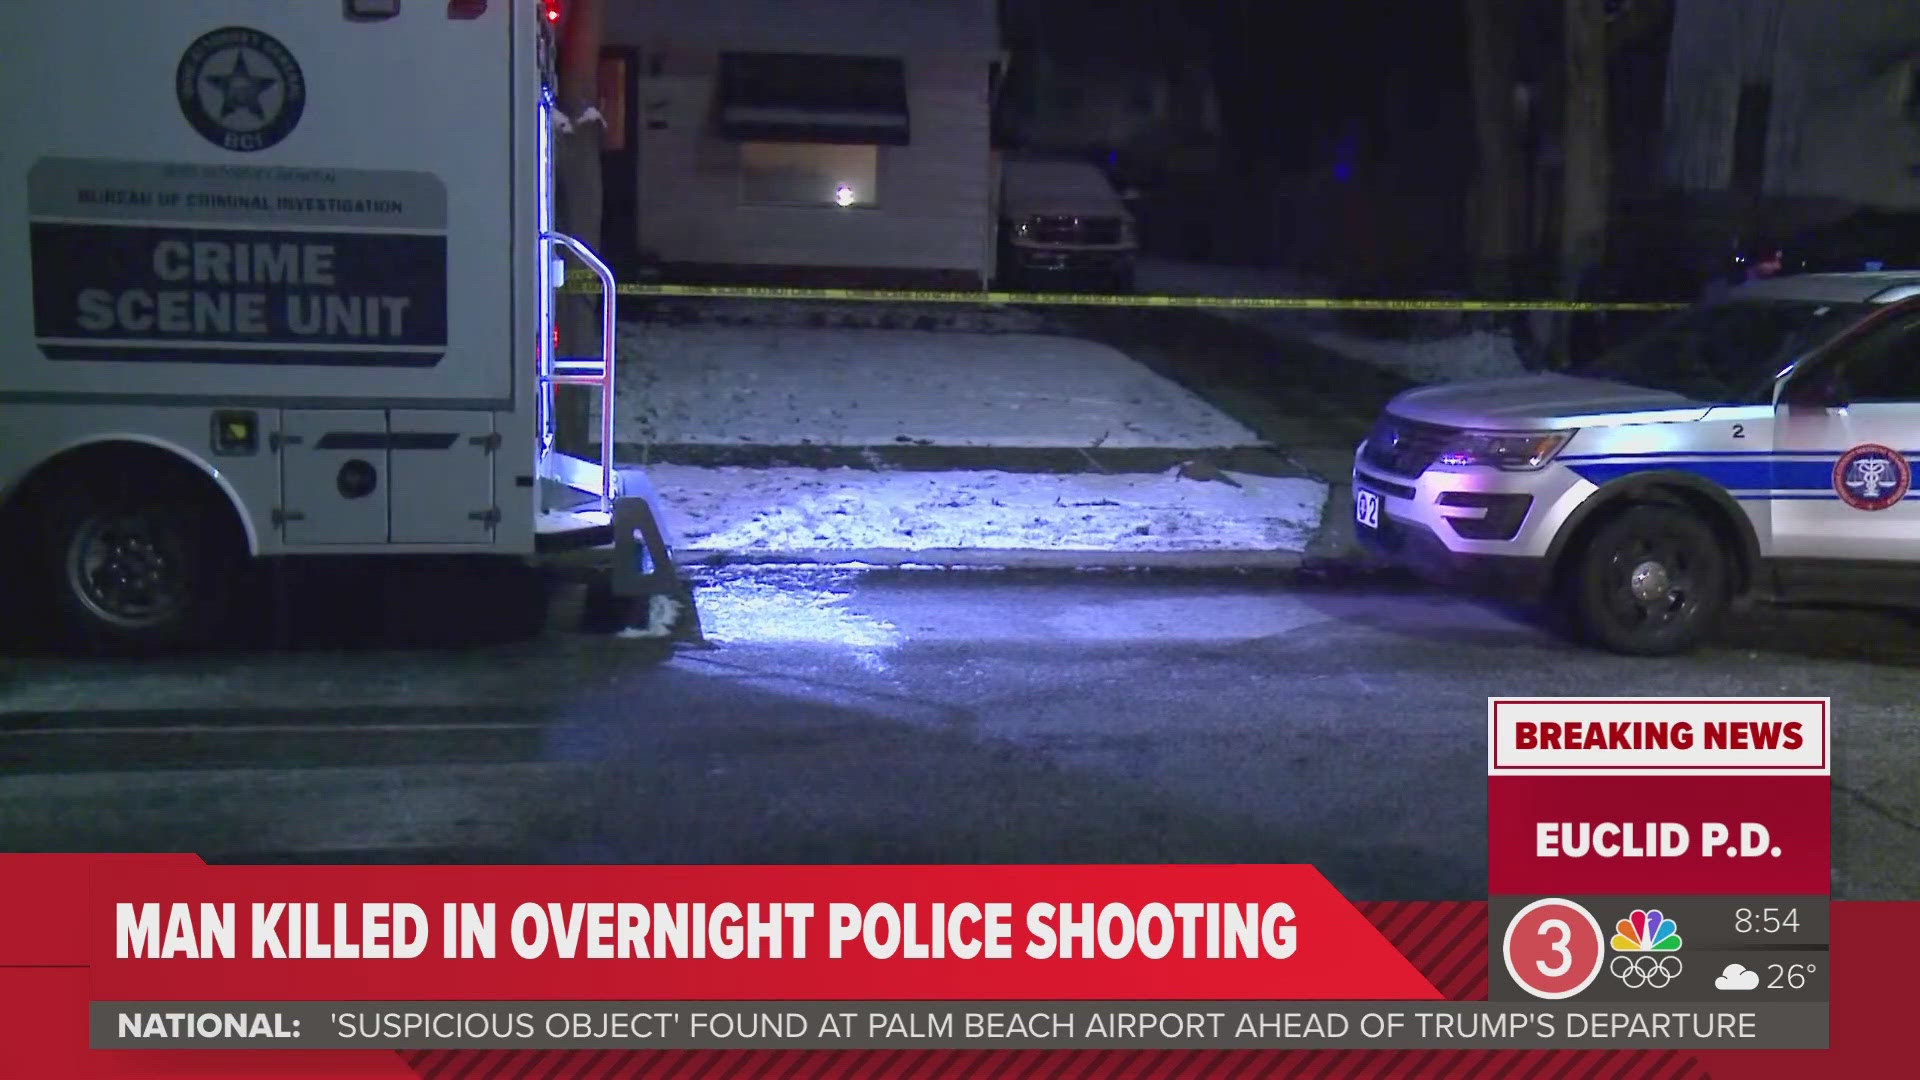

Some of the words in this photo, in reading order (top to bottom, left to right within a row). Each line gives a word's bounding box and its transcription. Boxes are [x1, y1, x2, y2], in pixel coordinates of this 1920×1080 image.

[223, 132, 264, 149] BCI
[77, 188, 151, 206] BUREAU
[157, 190, 179, 208] OF
[186, 191, 269, 211] CRIMINAL
[276, 196, 402, 213] INVESTIGATION
[153, 240, 336, 286] CRIME
[77, 288, 268, 334] SCENE
[287, 295, 410, 337] UNIT
[1732, 423, 1745, 439] 2
